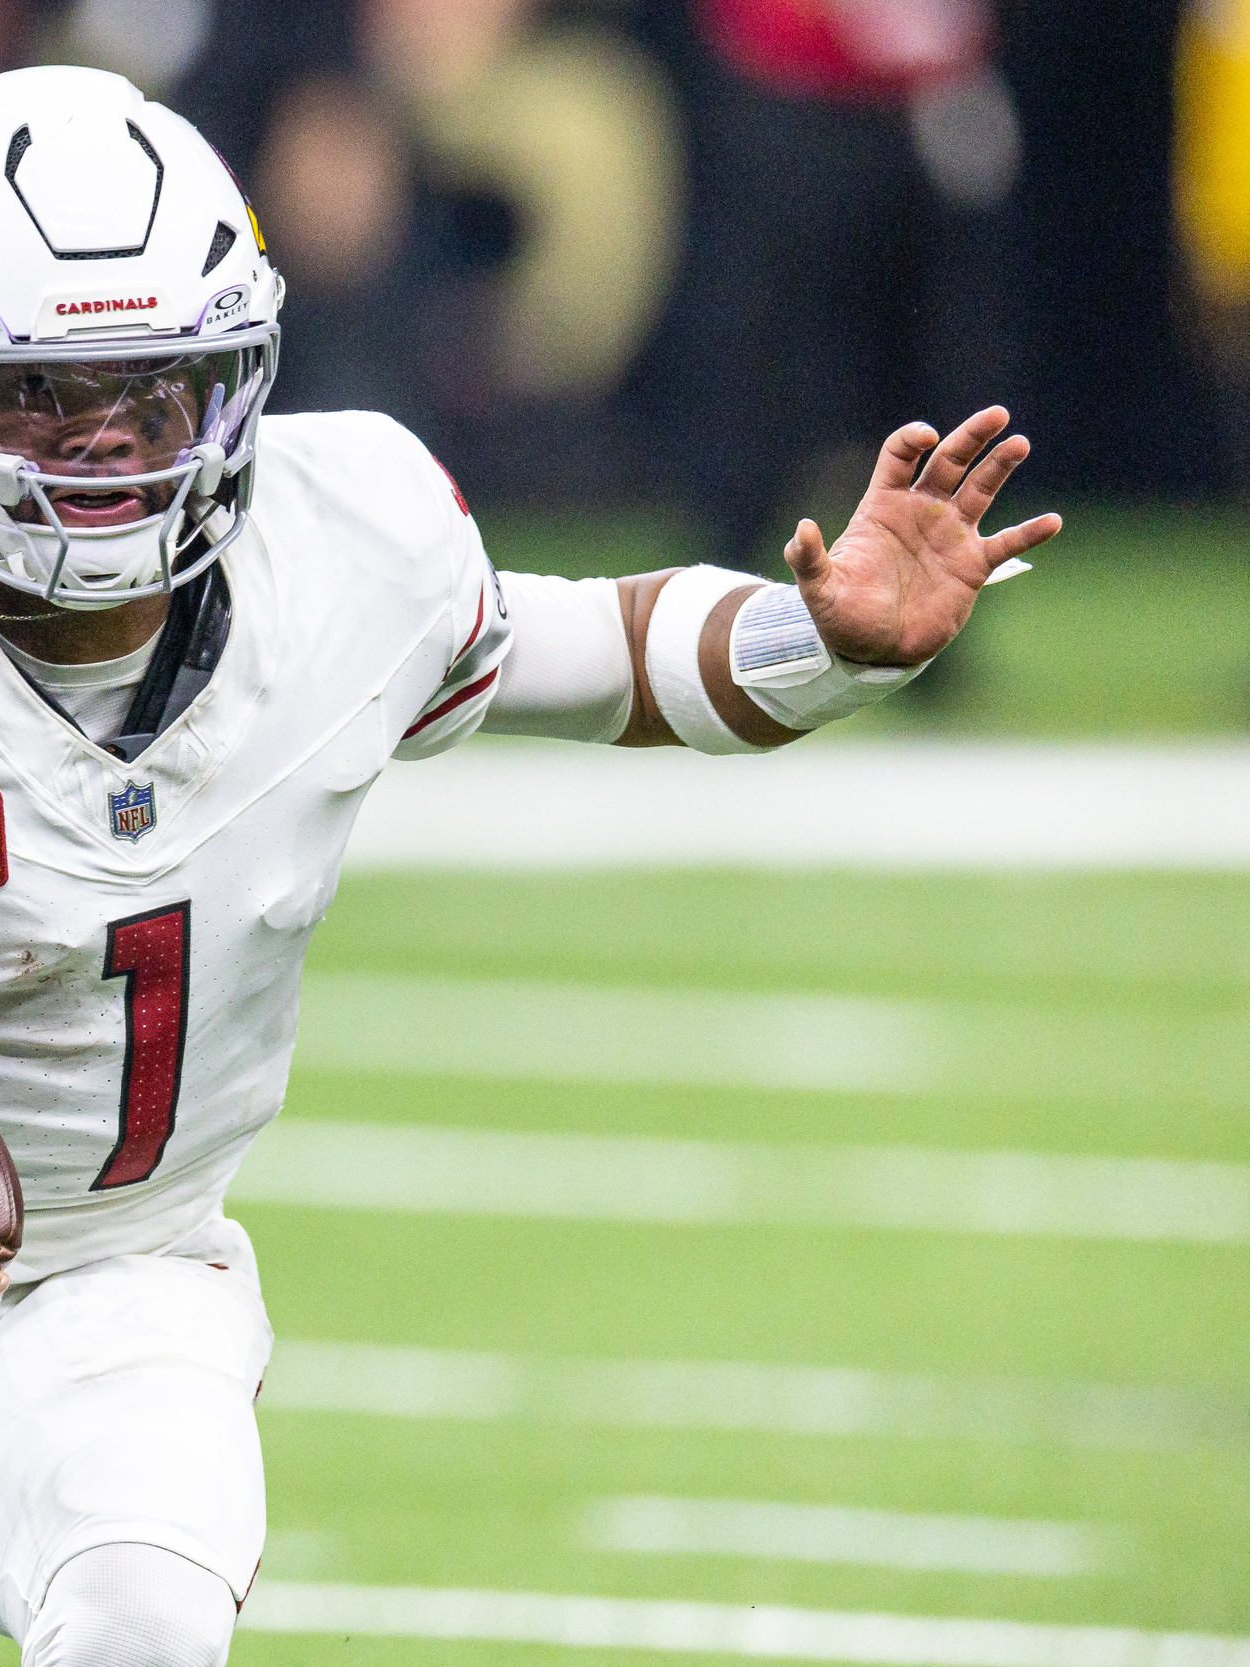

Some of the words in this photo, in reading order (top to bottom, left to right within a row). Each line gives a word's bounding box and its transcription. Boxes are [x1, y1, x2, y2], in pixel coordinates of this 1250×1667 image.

[55, 296, 158, 315] CARDINALS
[206, 300, 250, 325] OAKLEY
[117, 806, 150, 832] NFL
[88, 898, 192, 1192] 1
